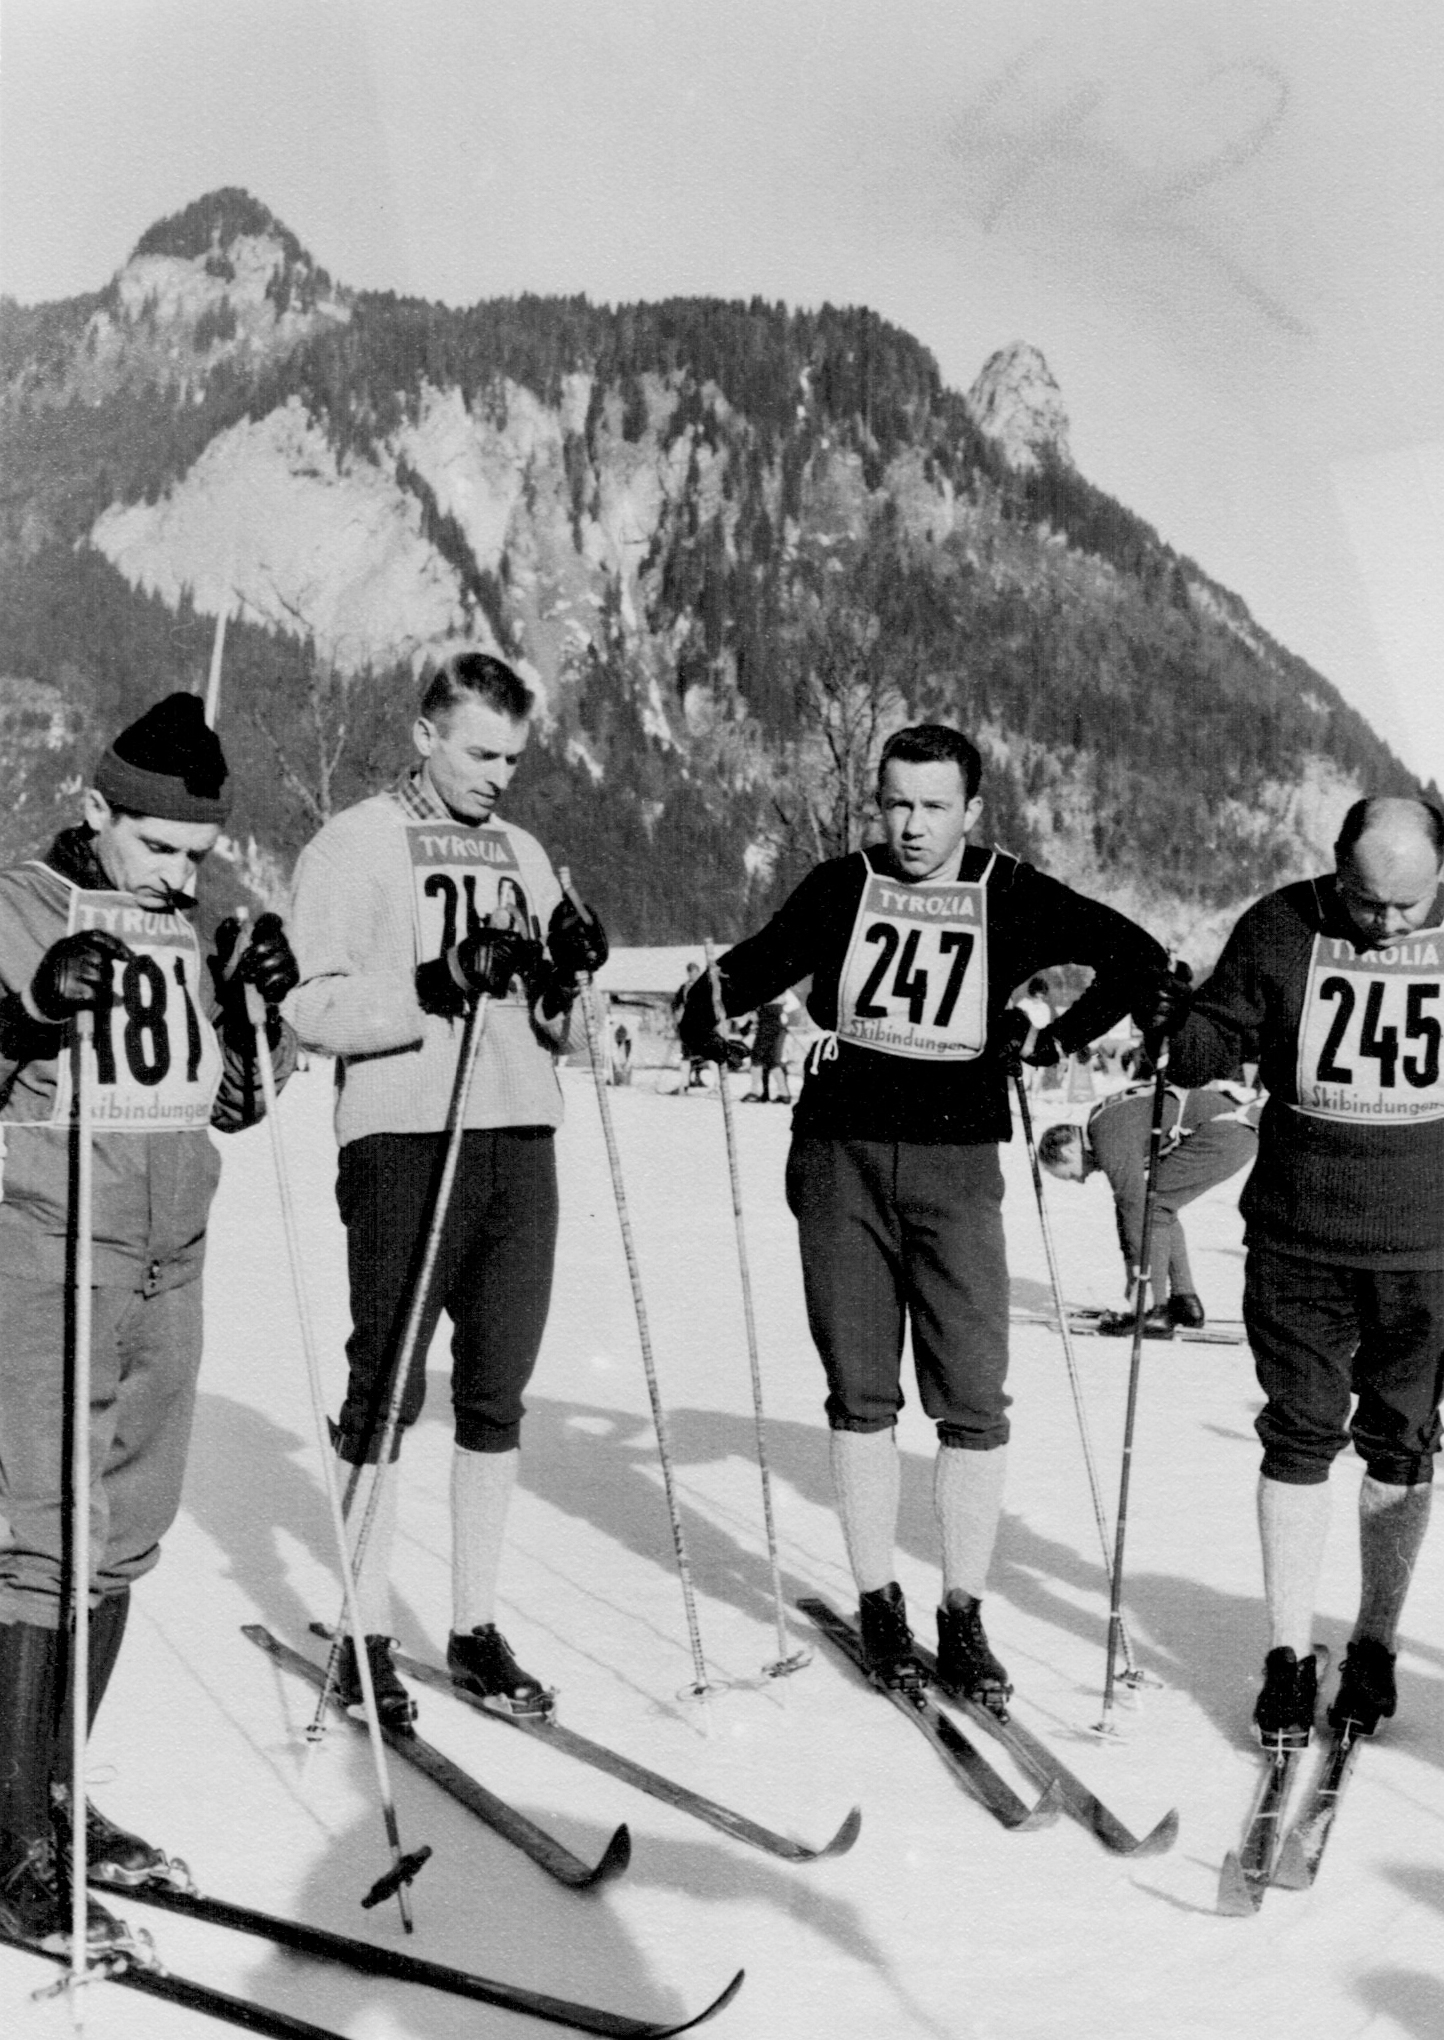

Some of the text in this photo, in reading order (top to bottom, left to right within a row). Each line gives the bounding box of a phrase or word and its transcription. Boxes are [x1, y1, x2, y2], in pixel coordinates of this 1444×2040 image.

[418, 834, 511, 864] TYROLIA
[879, 888, 975, 918] TYROLIA
[854, 921, 975, 1028] 247
[850, 1018, 968, 1054] Skibindungen
[1316, 975, 1441, 1089] 245
[1311, 1084, 1439, 1116] Skibindungen
